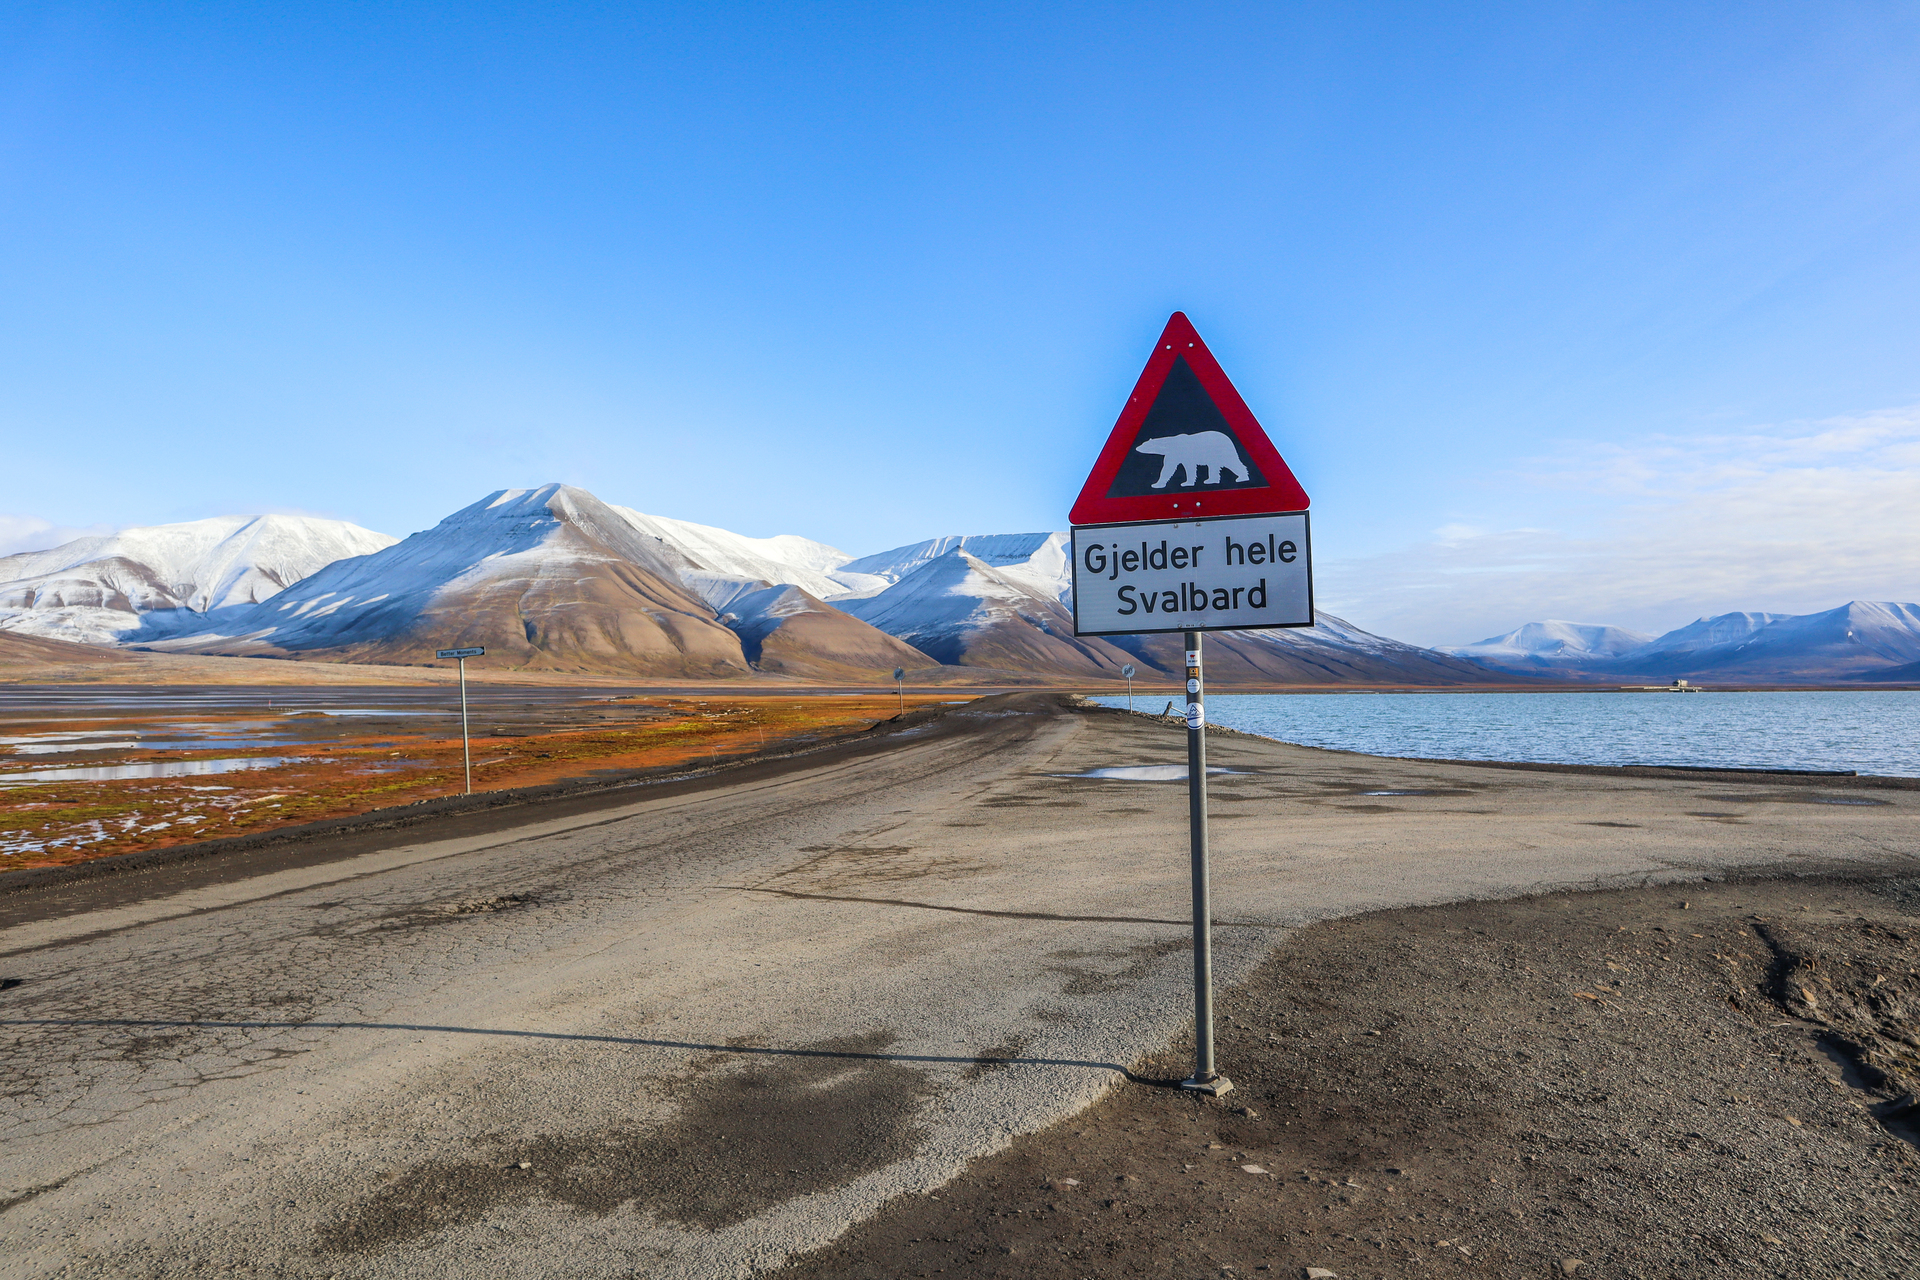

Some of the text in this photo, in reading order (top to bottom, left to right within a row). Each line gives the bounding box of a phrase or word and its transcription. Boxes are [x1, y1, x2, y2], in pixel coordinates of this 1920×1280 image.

[1084, 533, 1297, 581] Gjelder hele
[1117, 578, 1267, 616] Svalbard
